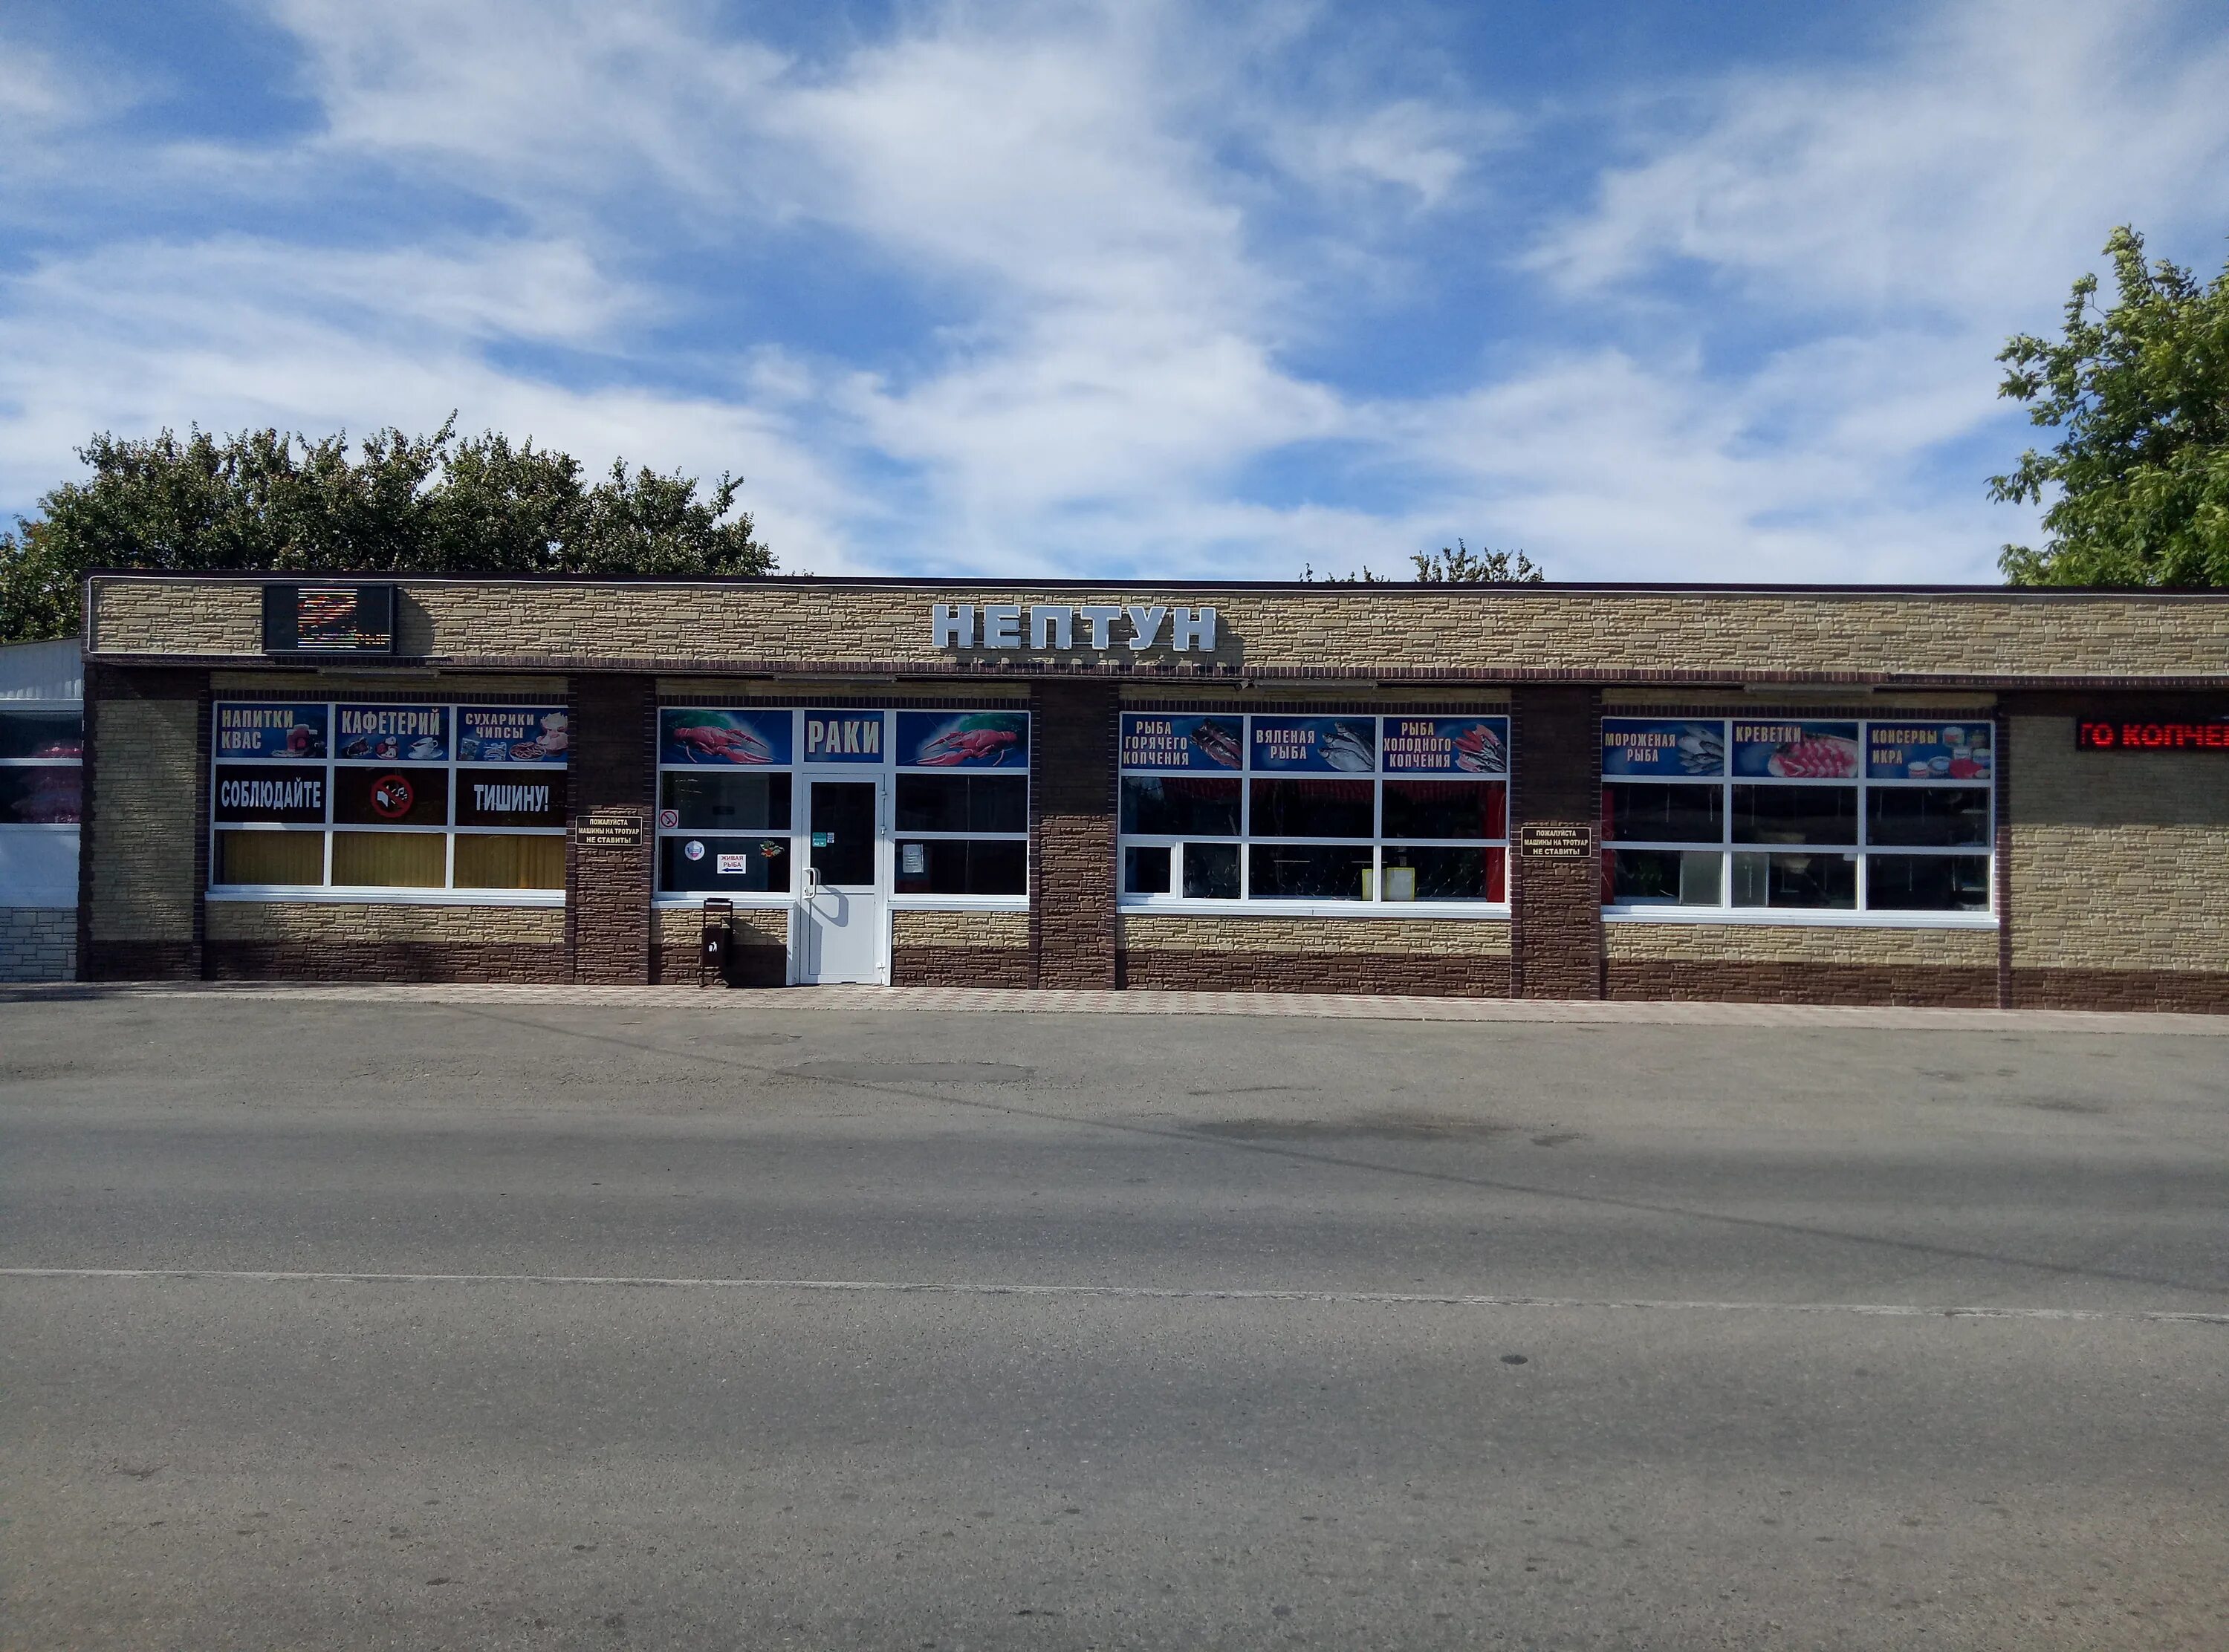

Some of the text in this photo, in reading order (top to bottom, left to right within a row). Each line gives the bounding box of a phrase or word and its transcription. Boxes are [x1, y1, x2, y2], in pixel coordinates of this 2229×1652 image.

[932, 605, 1216, 652] НЕПТУН
[222, 710, 293, 728] НАПИТКИ
[342, 709, 440, 735] КАФЕТЕРИЙ
[466, 713, 534, 726] СУХАРИКИ
[476, 727, 523, 738] ЧИПСЫ
[1136, 721, 1172, 735] РЫБА
[1401, 722, 1434, 735] РЫБА
[1736, 726, 1801, 743] КРЕВЕТКИ
[2081, 723, 2229, 745] ГО КОПЧЕ
[222, 732, 262, 749] КВАС
[808, 721, 879, 753] РАКИ
[1125, 736, 1187, 750] ГОРЯЧЕГО
[1256, 729, 1315, 744] ВЯЛЕНАЯ
[1605, 733, 1675, 747] МОРОЖЕНАЯ
[1872, 729, 1937, 744] КОНСЕРВЫ
[1271, 746, 1307, 759] РЫБА
[1383, 738, 1451, 753] ХОЛОДНОГО
[1123, 751, 1189, 765] КОПЧЕНИЯ
[1389, 754, 1450, 767] КОПЧЕНИЯ
[1627, 749, 1658, 762] РЫБА
[1872, 749, 1903, 764] ИКРА
[221, 777, 321, 810] СОБЛЮДАЙТЕ
[474, 784, 548, 811] ТИШИНУ!
